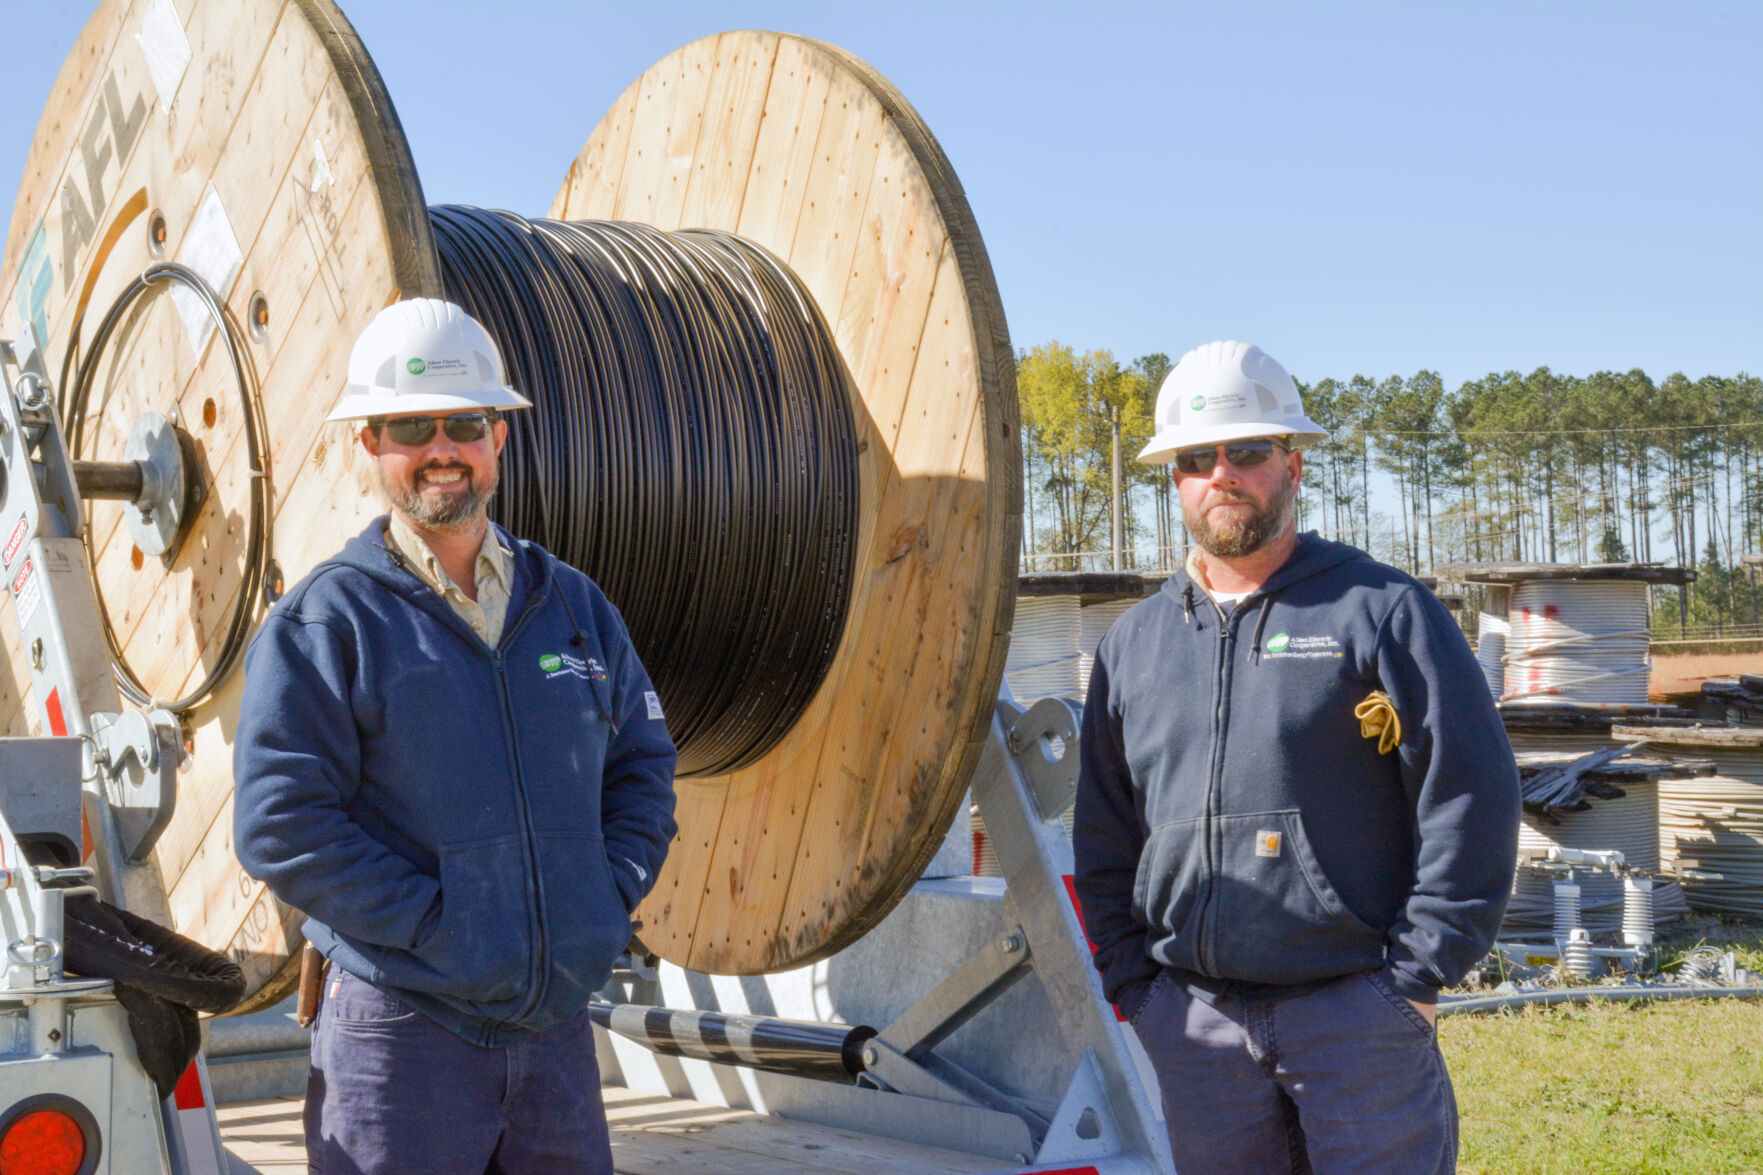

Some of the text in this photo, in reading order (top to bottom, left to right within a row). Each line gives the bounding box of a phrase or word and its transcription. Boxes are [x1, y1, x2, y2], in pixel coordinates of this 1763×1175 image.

[60, 68, 148, 297] AFL
[319, 193, 347, 271] ROLL
[5, 522, 26, 559] DANGER
